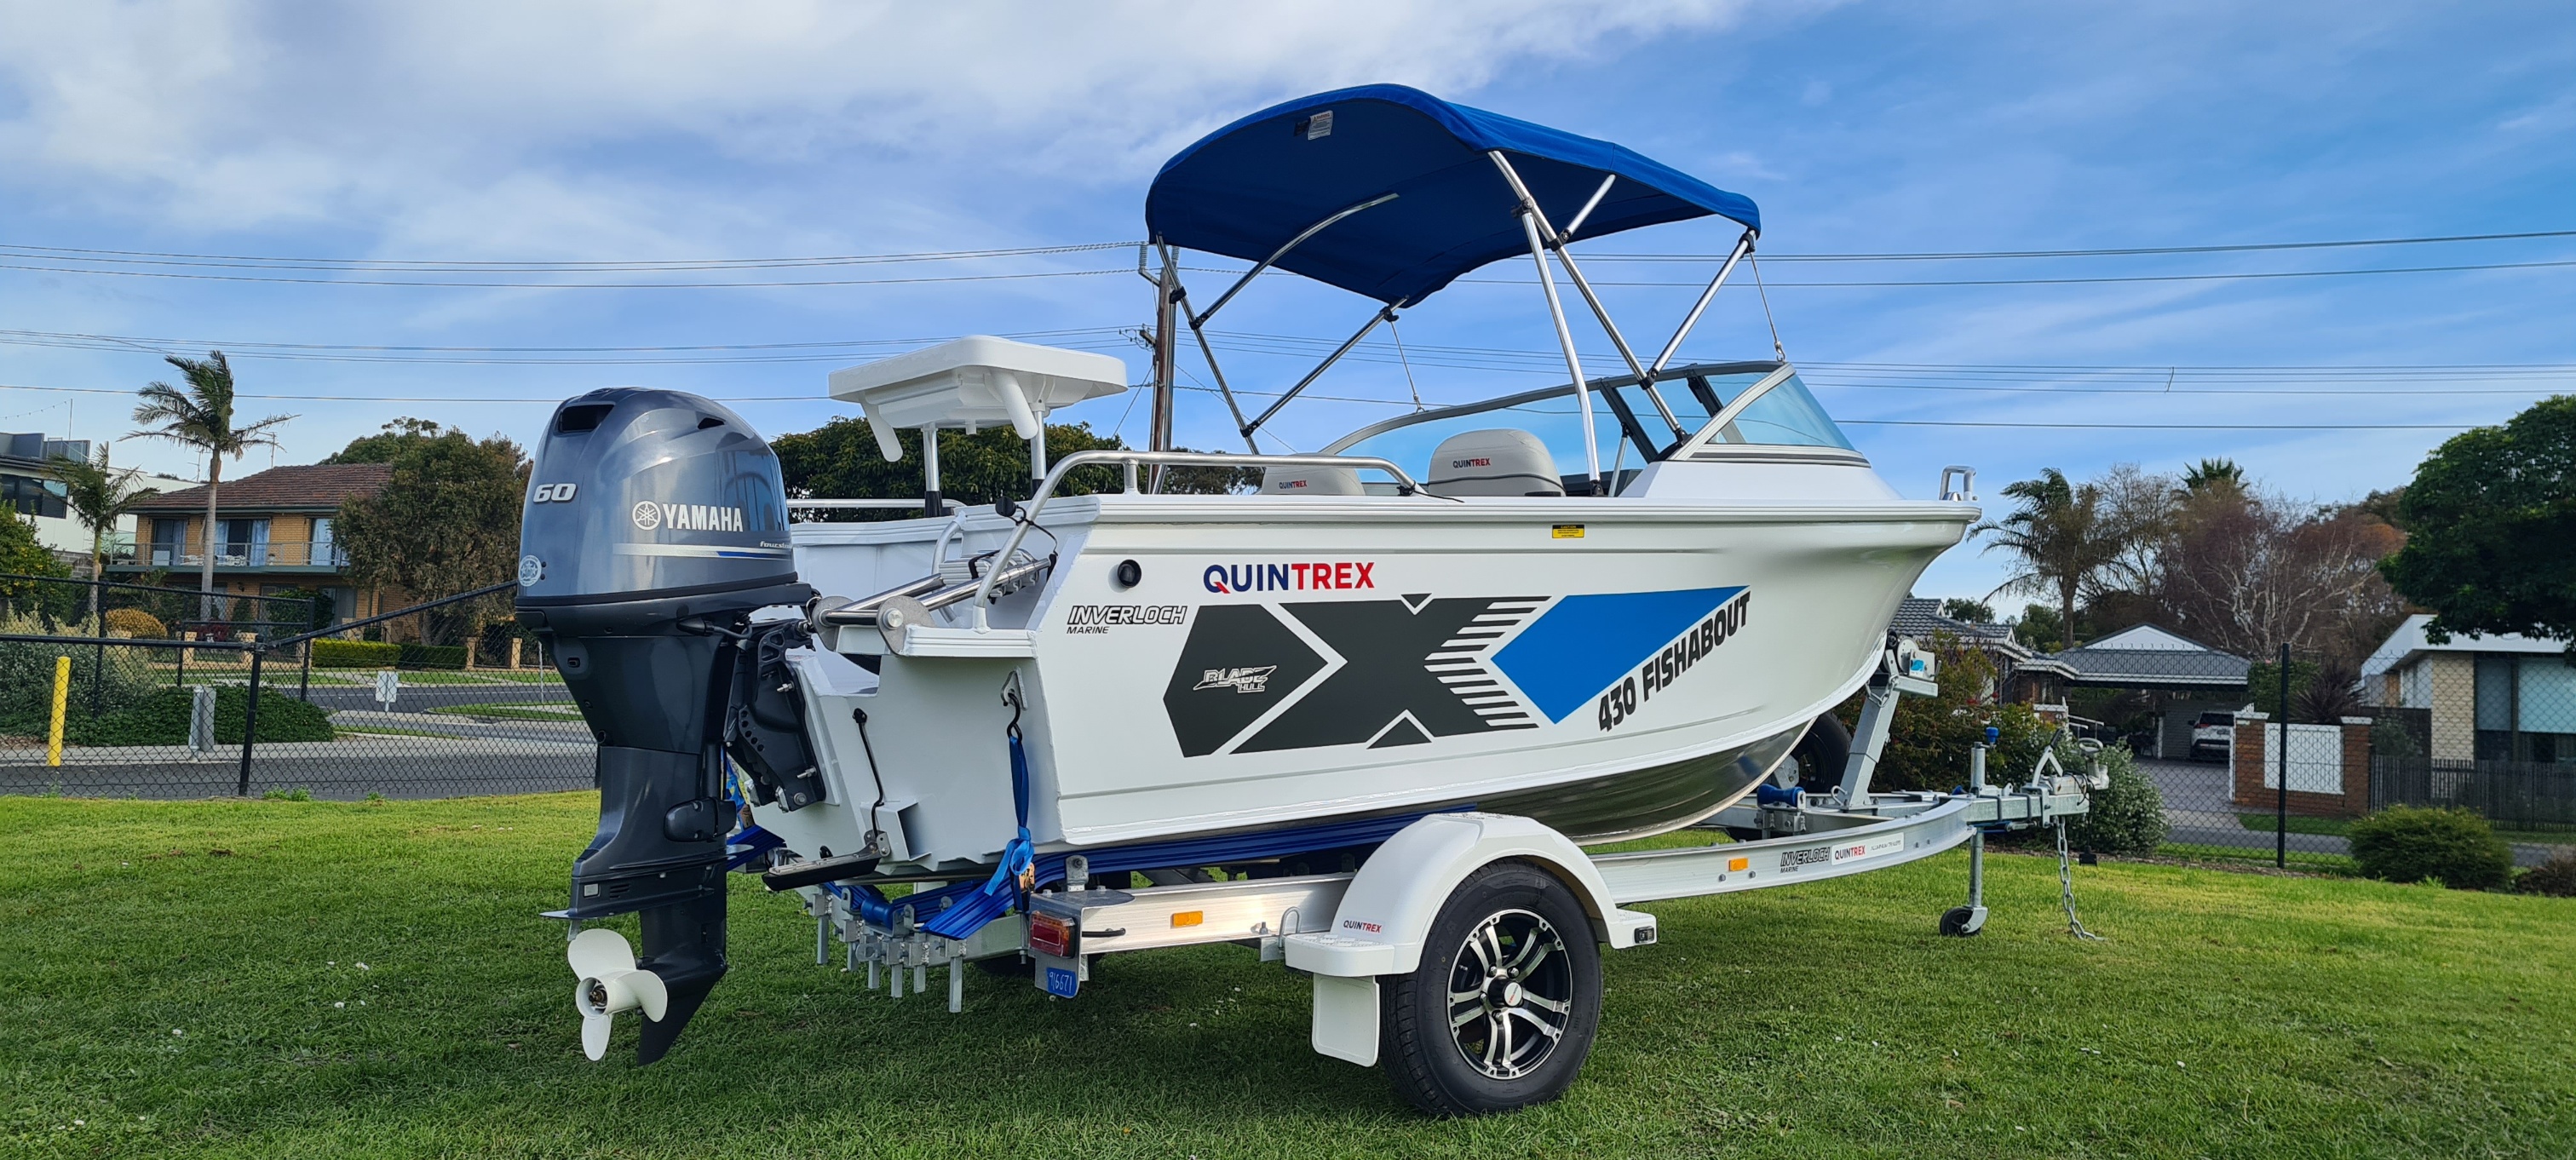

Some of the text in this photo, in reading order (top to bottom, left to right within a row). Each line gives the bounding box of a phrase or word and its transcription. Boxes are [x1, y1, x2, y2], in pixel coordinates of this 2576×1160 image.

[1452, 457, 1491, 468] QUINTREX
[532, 483, 578, 503] 60
[1279, 480, 1308, 490] QUINTREX
[662, 503, 744, 532] YAMAHA
[1203, 562, 1375, 594] QUINTREX
[1067, 606, 1188, 625] INVERLOCH
[1066, 626, 1110, 635] MARINE
[1598, 590, 1751, 732] 430 FISHABOUT
[1198, 666, 1273, 688] BLADE
[1239, 683, 1265, 692] HULL
[1780, 847, 1831, 867] INVERLOCH
[1834, 845, 1866, 860] QUINTREX
[1780, 865, 1799, 874] MARINE
[1343, 920, 1382, 933] QUINTREX
